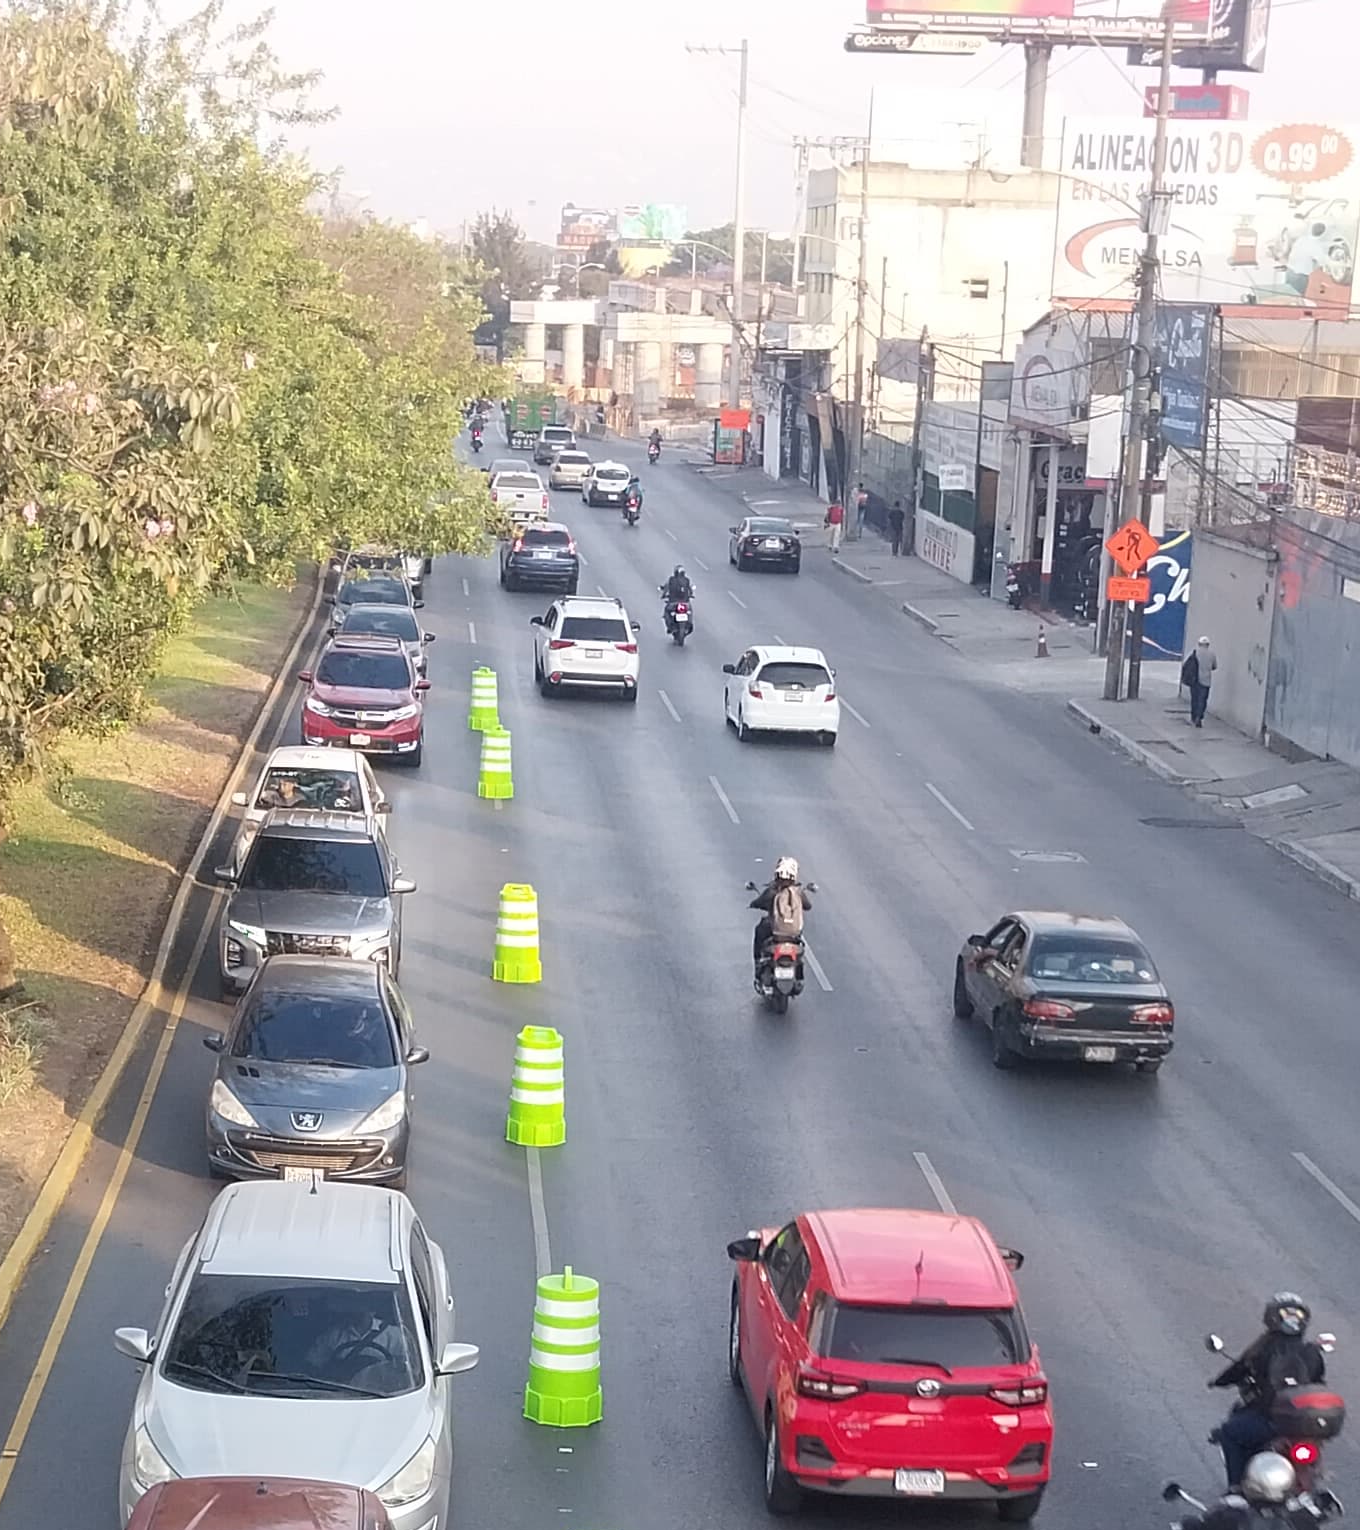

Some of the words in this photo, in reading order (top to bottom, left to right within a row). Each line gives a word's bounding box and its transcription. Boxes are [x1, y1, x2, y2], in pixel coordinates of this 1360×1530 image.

[1207, 131, 1244, 174] 3D
[1072, 180, 1092, 201] EN
[1099, 181, 1129, 202] LAS
